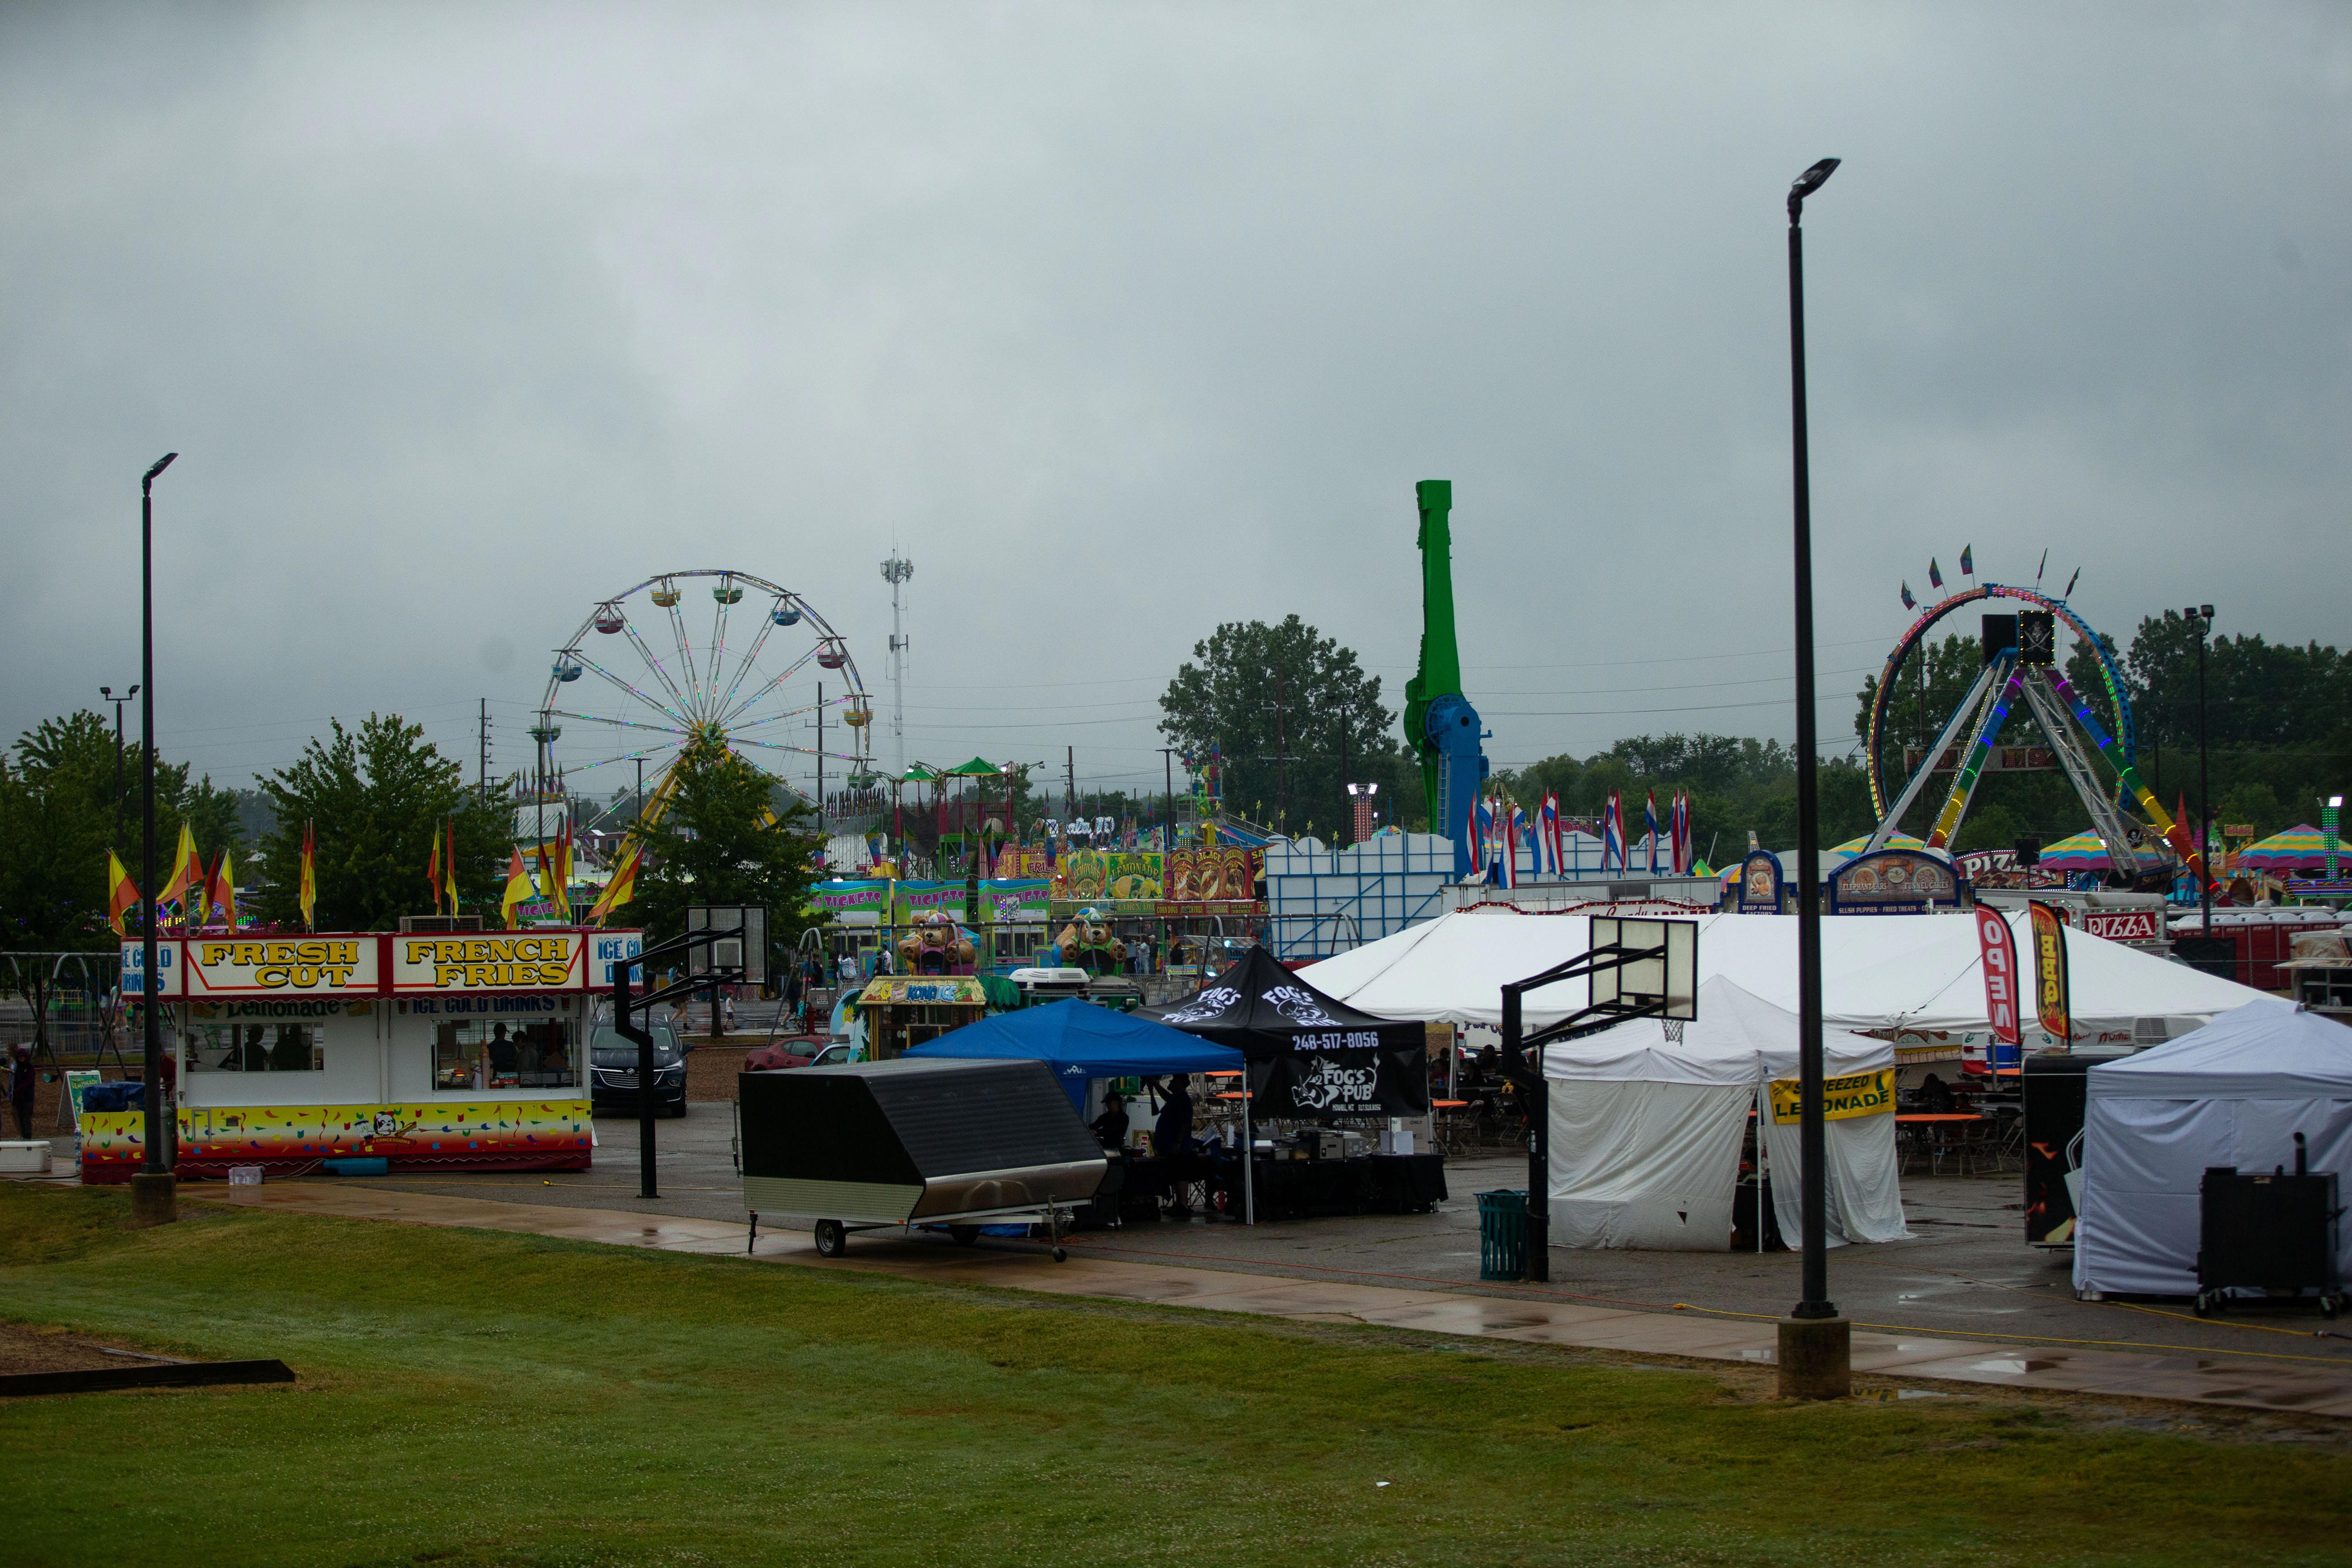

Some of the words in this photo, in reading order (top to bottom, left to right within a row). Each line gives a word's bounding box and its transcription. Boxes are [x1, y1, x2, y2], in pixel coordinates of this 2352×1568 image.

[1111, 863, 1159, 881] LEMONADE
[1929, 881, 1949, 889] CAKES
[824, 891, 882, 908] TICKETS
[909, 889, 965, 907] TICKETS
[1118, 901, 1141, 911] CORN
[517, 902, 555, 917] TICKE
[2087, 915, 2155, 937] PIZZA
[202, 942, 360, 966] FRESH
[407, 938, 569, 964] FRENCH
[598, 937, 623, 960] ICE
[255, 966, 353, 988] CUT
[434, 962, 569, 987] FRIES
[905, 984, 938, 1002] KONA
[938, 984, 958, 1002] ICE
[1197, 986, 1242, 1006] FOG'S
[1261, 985, 1314, 1005] FOG'S
[226, 999, 340, 1018] Lemonade
[413, 997, 440, 1014] ICE
[445, 996, 488, 1013] COLD
[493, 995, 555, 1012] DRINKS
[1292, 1031, 1380, 1051] 248-517-8056
[1322, 1069, 1366, 1085] FOG'S
[1342, 1084, 1372, 1103] PUB
[1775, 1090, 1889, 1117] LEONADE
